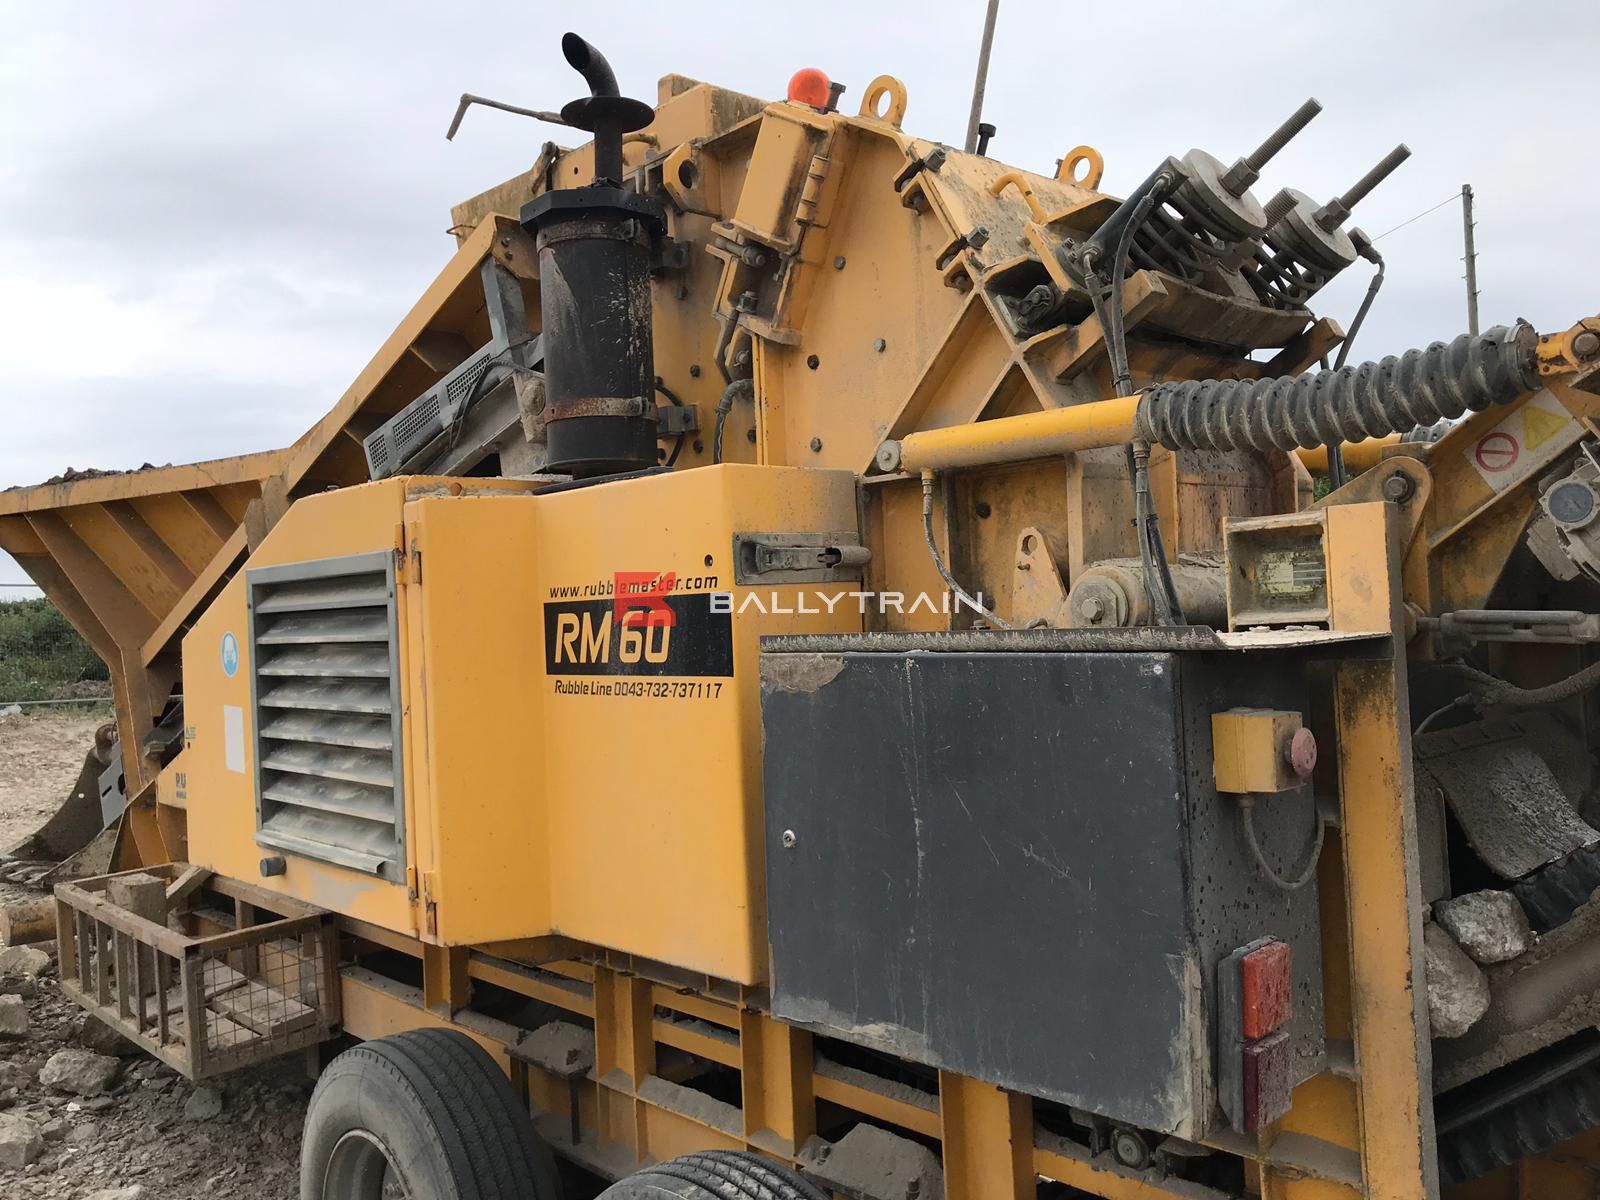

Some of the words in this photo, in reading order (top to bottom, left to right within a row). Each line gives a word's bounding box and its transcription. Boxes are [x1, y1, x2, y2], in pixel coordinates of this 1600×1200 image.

[550, 576, 718, 598] www.rubblemaster.com
[554, 610, 613, 664] RM
[619, 609, 672, 664] 60
[554, 680, 589, 695] Rubble
[591, 680, 612, 696] Line
[614, 681, 723, 699] 0043-732-737117
